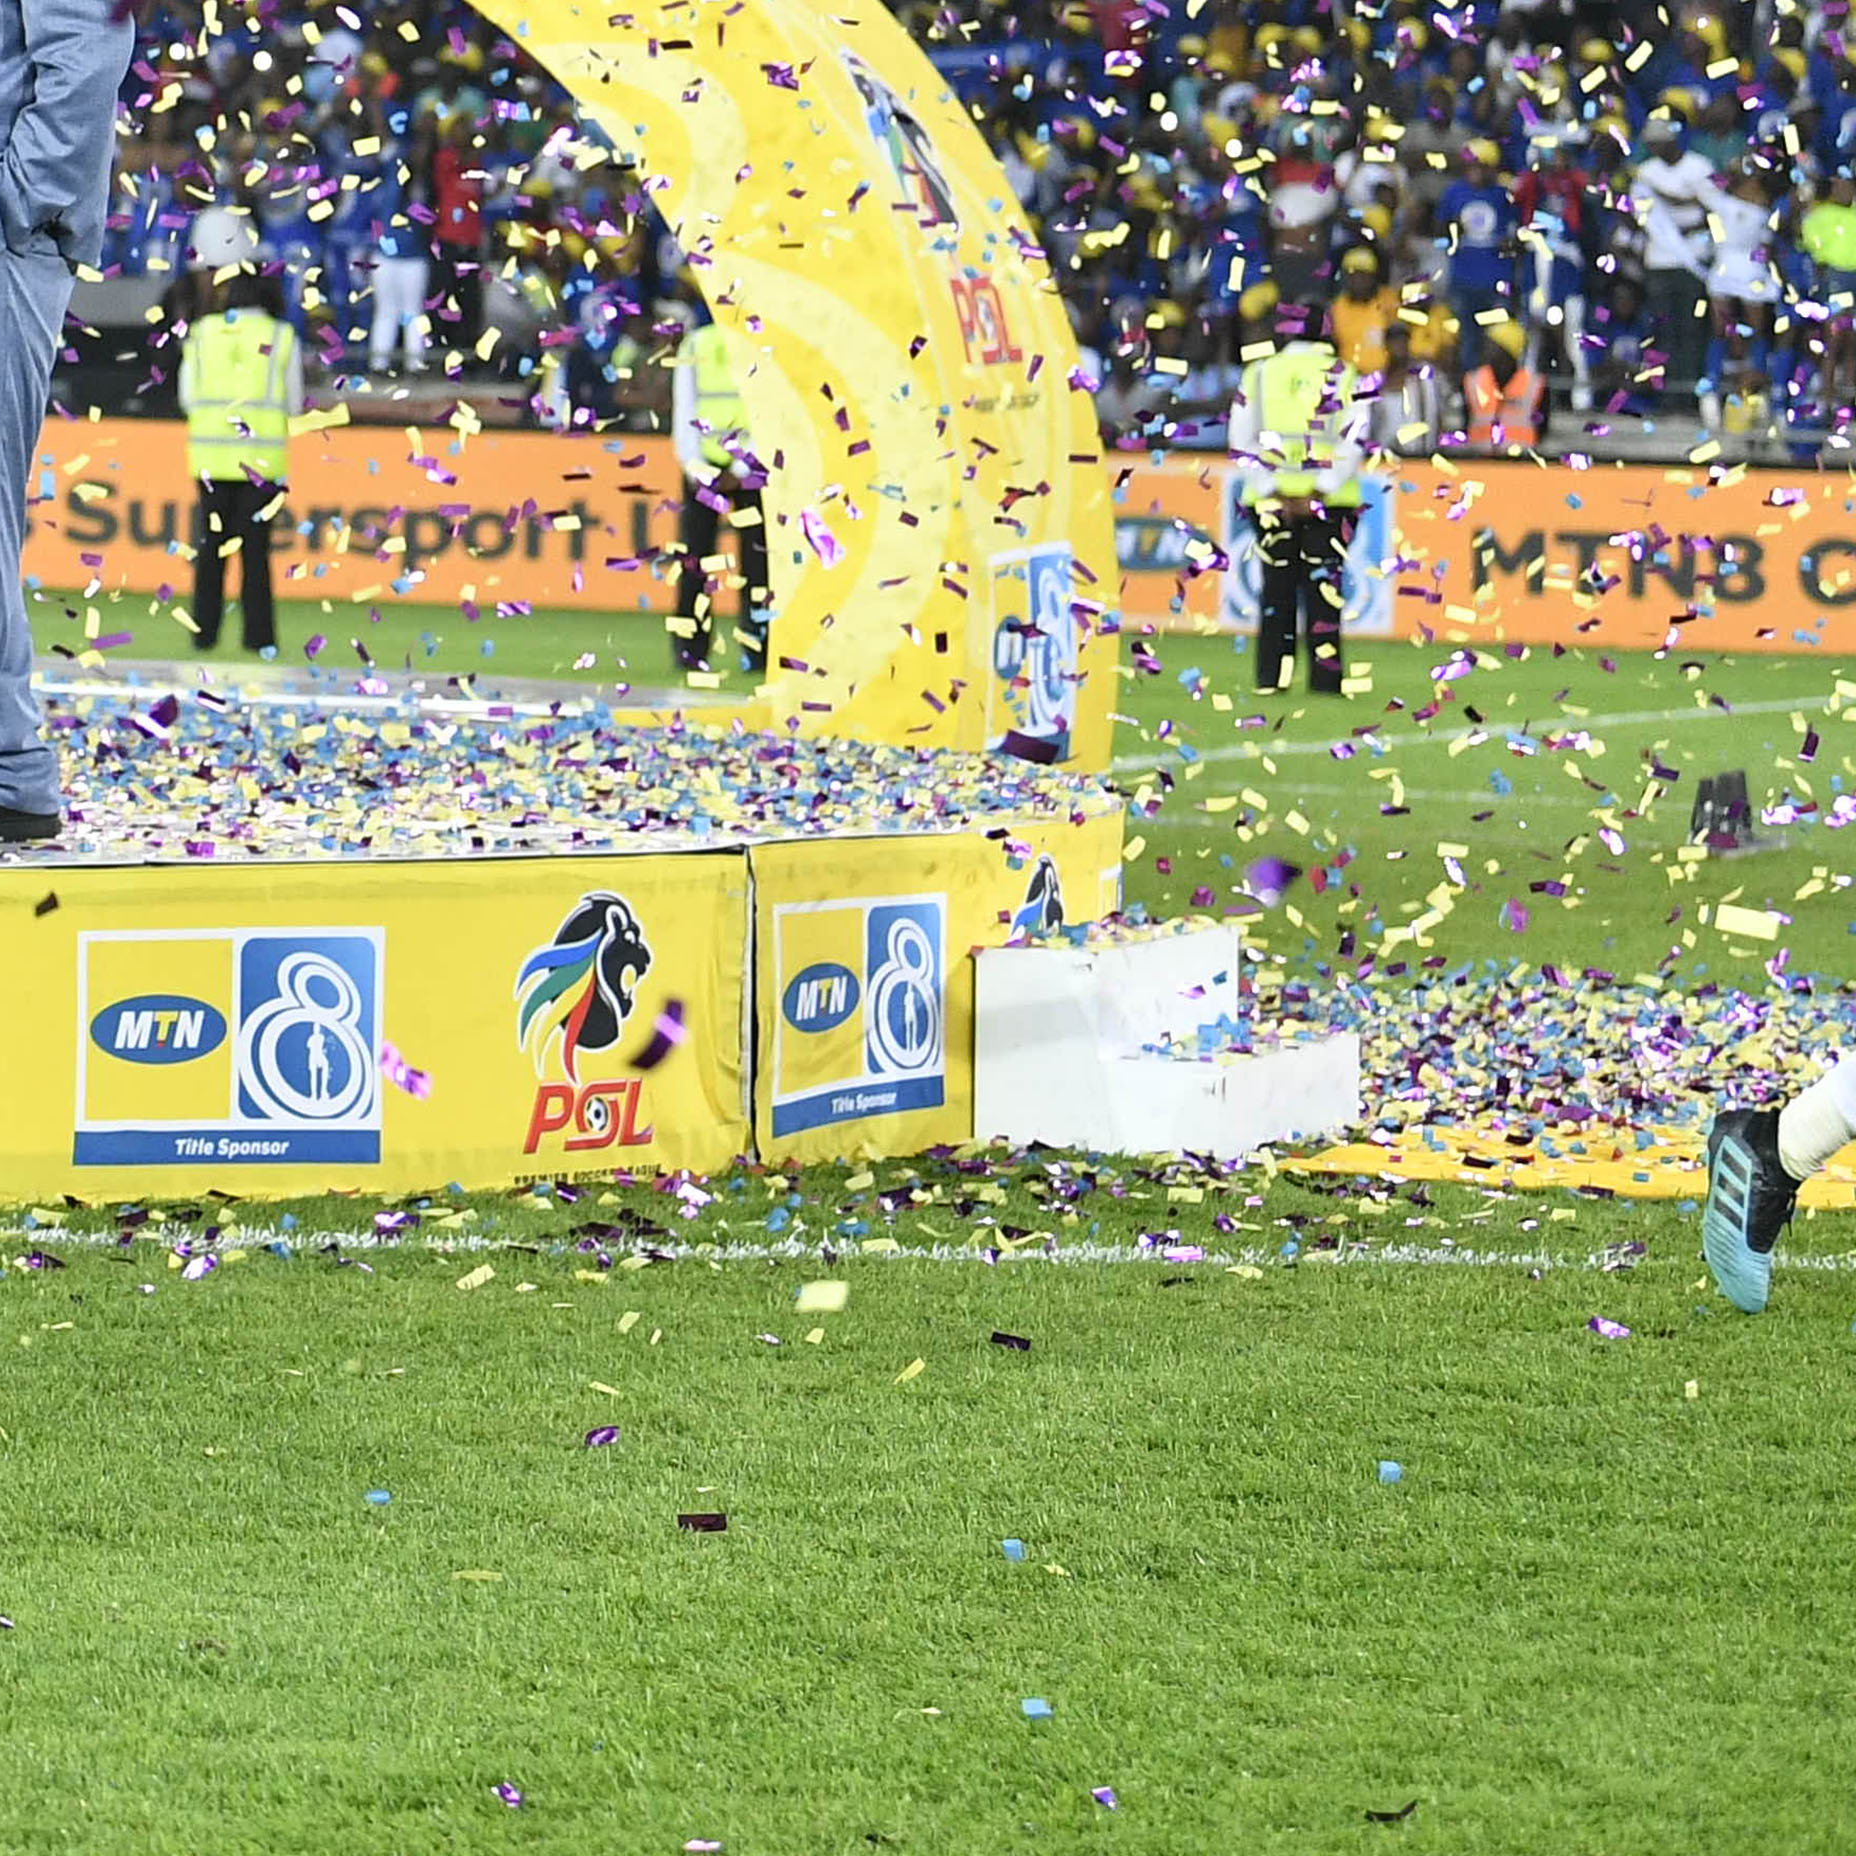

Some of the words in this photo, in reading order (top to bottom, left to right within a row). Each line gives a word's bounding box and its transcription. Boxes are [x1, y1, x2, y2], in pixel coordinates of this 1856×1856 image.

[1470, 527, 1767, 607] MTN8
[795, 975, 848, 1022] MTN
[114, 1009, 207, 1050] MTN
[522, 1076, 656, 1155] PSL
[174, 1137, 214, 1158] Title
[217, 1138, 290, 1160] Sponsor
